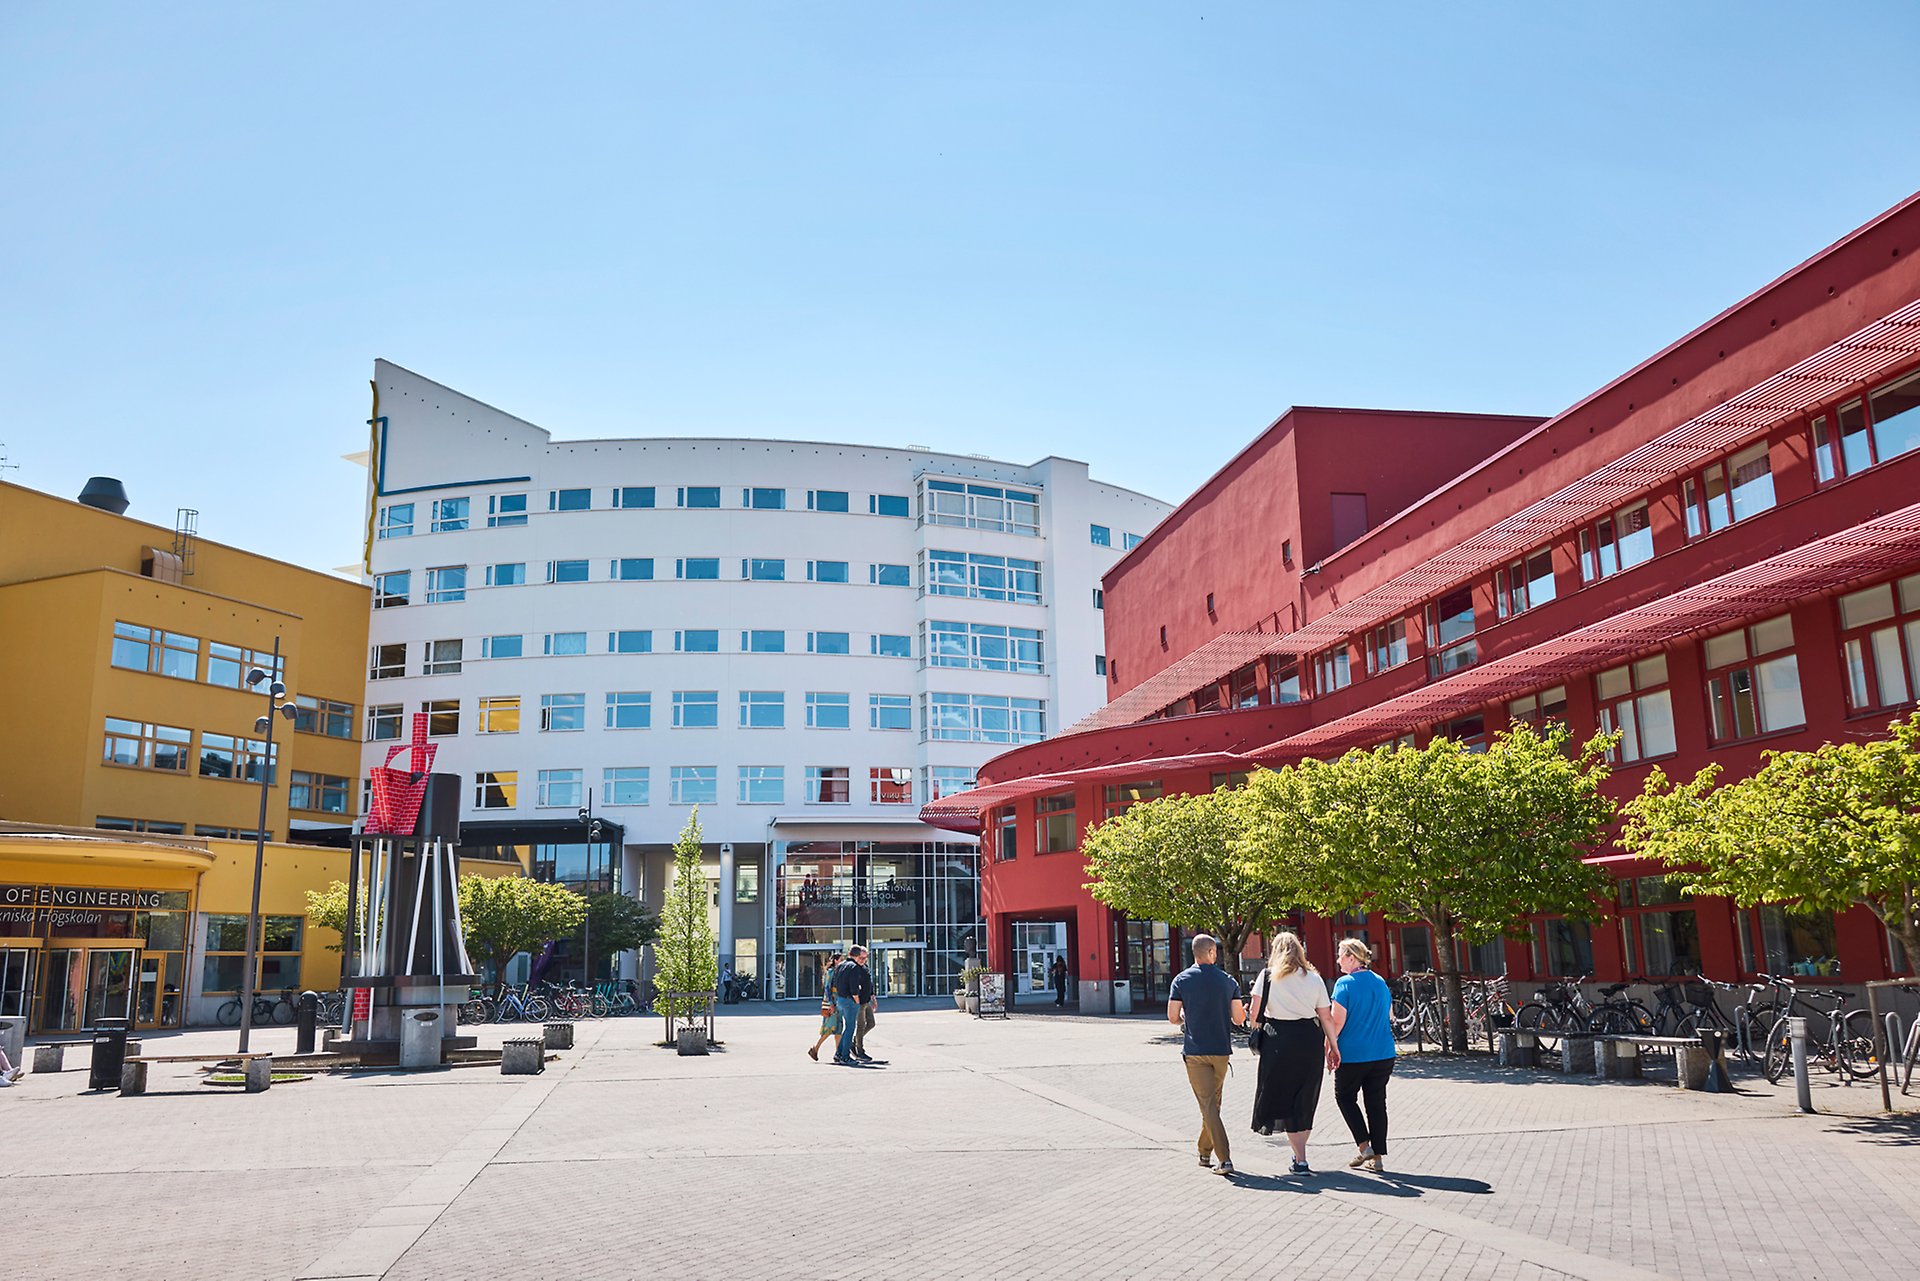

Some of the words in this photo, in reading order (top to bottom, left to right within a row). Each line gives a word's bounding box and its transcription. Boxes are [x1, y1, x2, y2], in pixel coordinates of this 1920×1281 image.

[6, 888, 31, 903] OF
[40, 889, 160, 907] ENGINEERING
[39, 909, 102, 927] Högskolan
